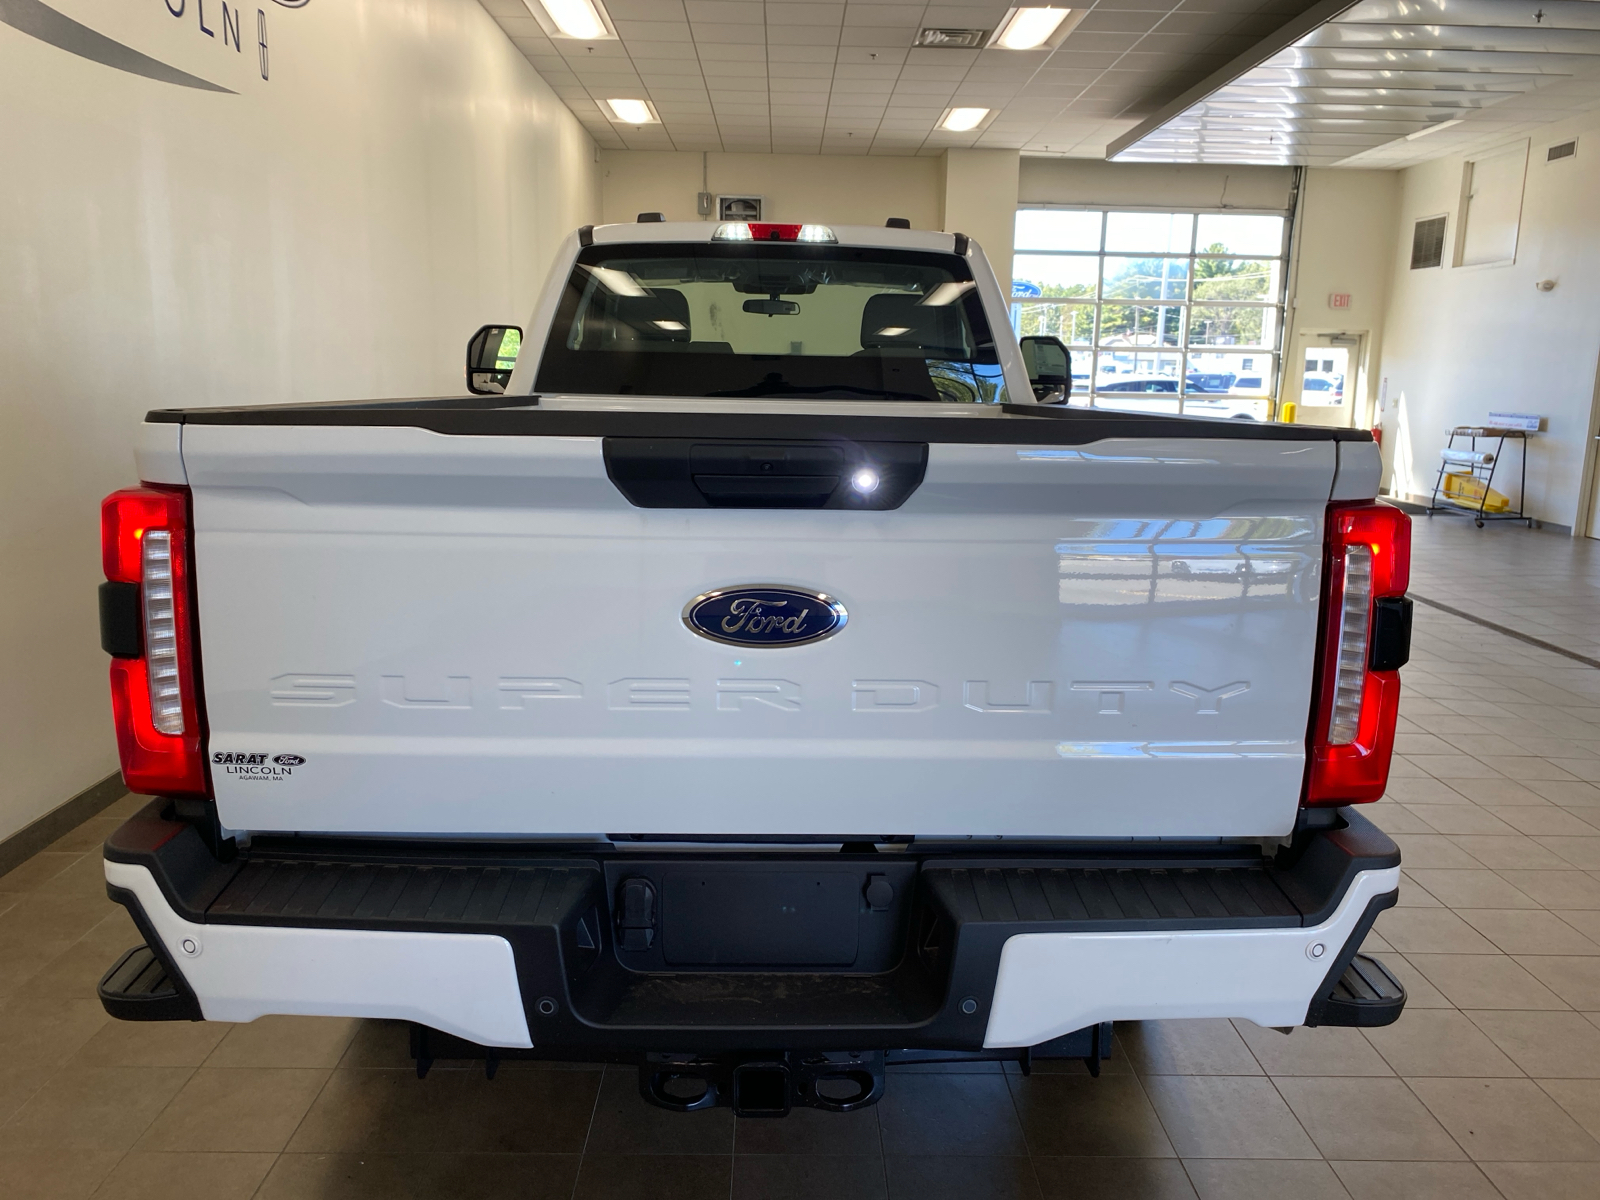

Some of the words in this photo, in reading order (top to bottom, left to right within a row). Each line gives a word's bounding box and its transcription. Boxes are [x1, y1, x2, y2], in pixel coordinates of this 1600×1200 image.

[1333, 294, 1350, 307] EXIT
[721, 598, 809, 634] Ford
[269, 673, 802, 711] SUPER
[851, 678, 1252, 715] DUTY
[212, 752, 268, 765] SARAT
[226, 766, 292, 775] LINCOLN
